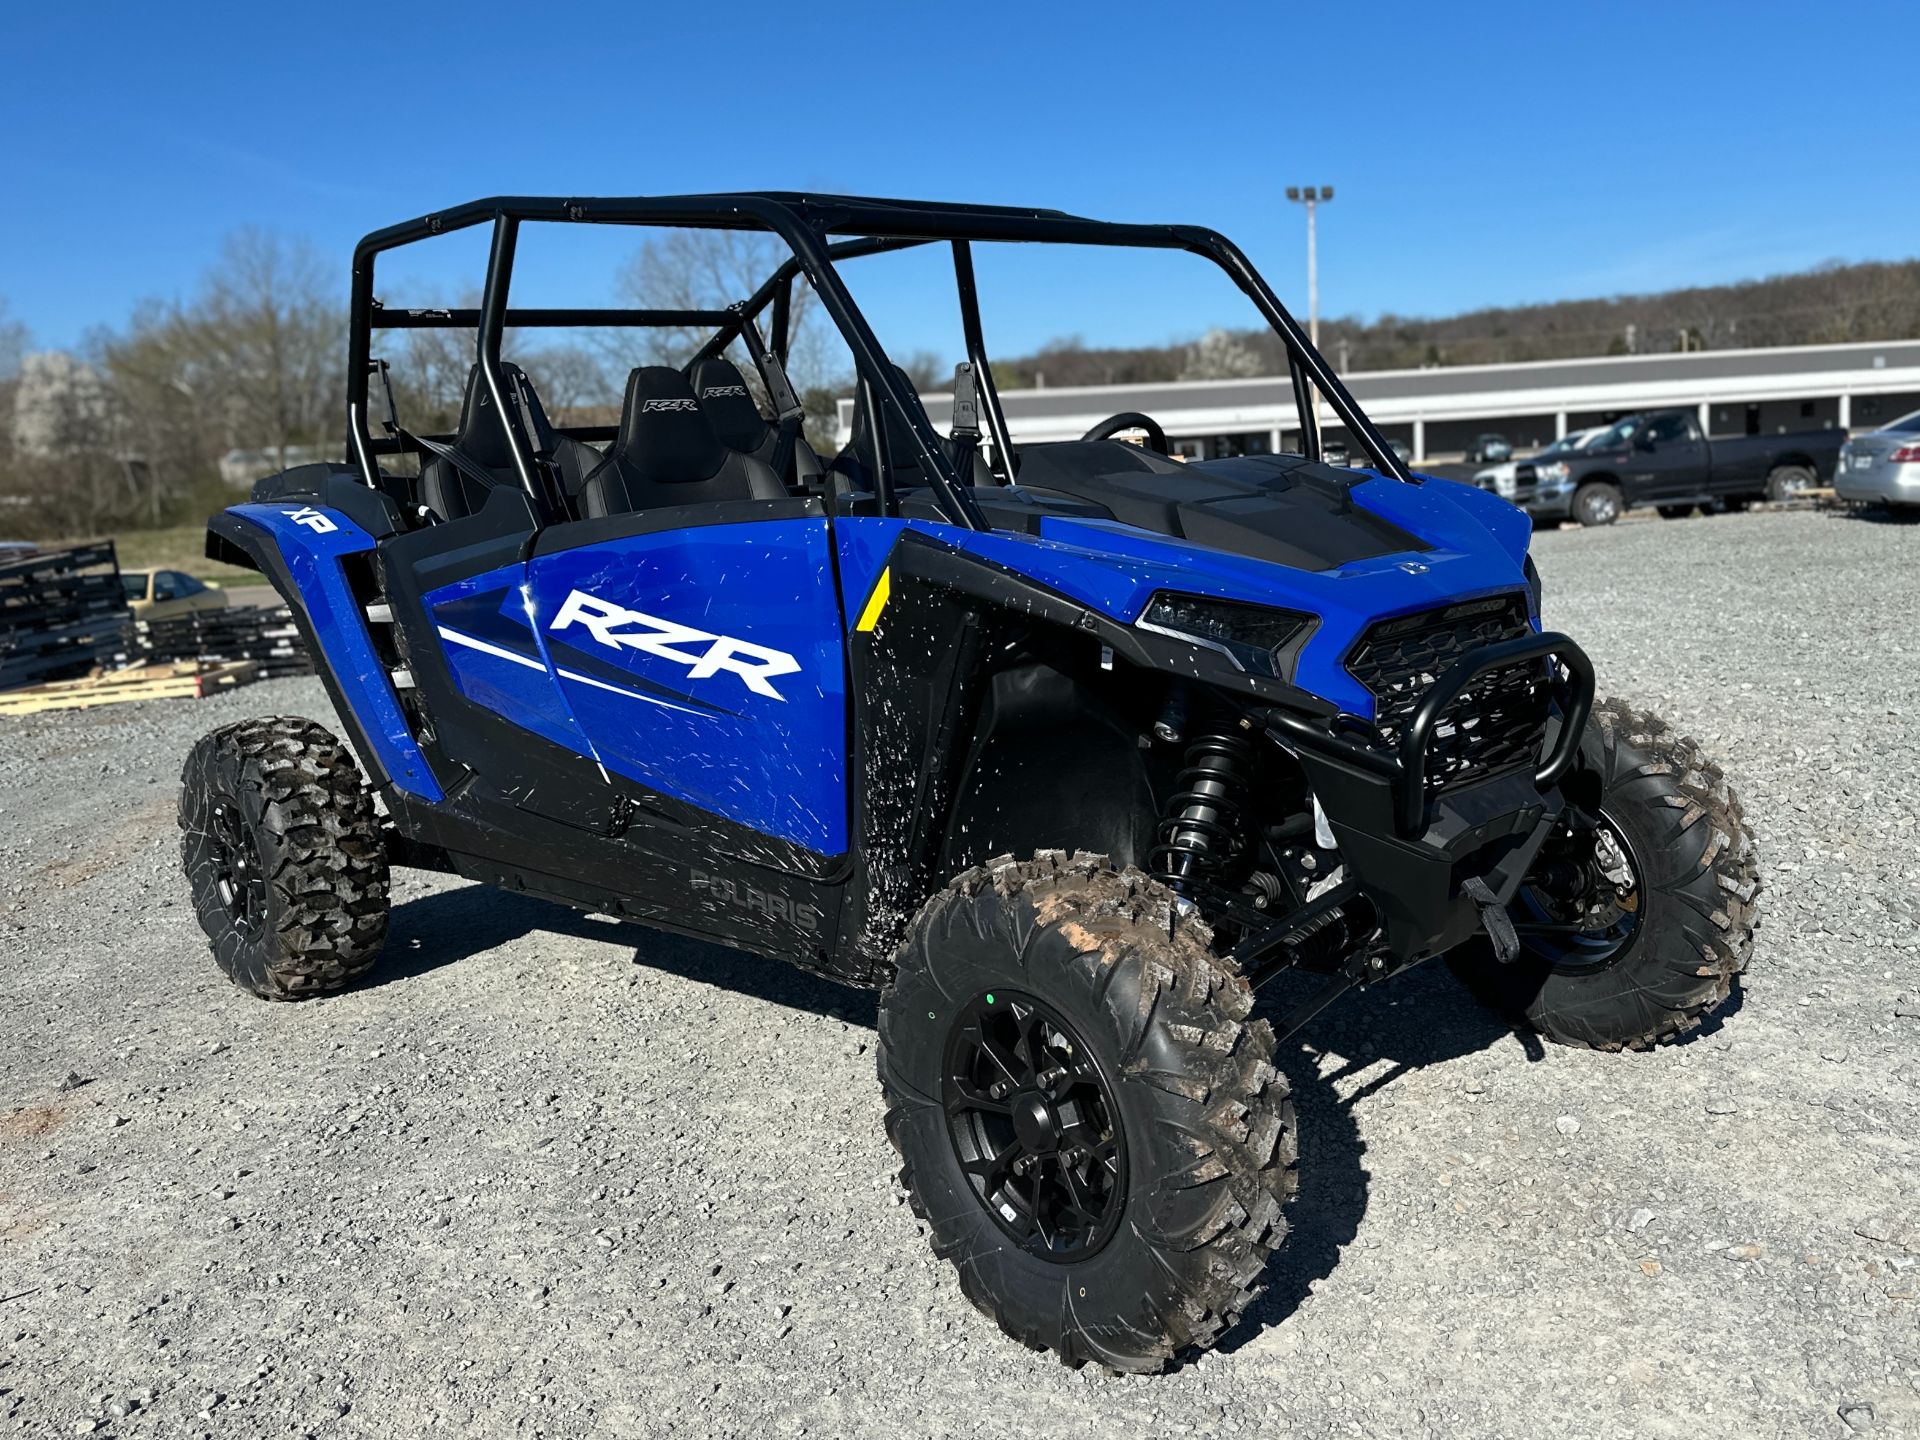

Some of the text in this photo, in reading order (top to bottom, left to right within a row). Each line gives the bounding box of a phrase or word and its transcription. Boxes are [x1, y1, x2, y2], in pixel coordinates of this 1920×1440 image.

[642, 398, 698, 412] RZR
[702, 385, 746, 399] RZR
[280, 506, 338, 534] XP
[549, 589, 802, 702] RZR
[689, 868, 818, 930] POLARIS
